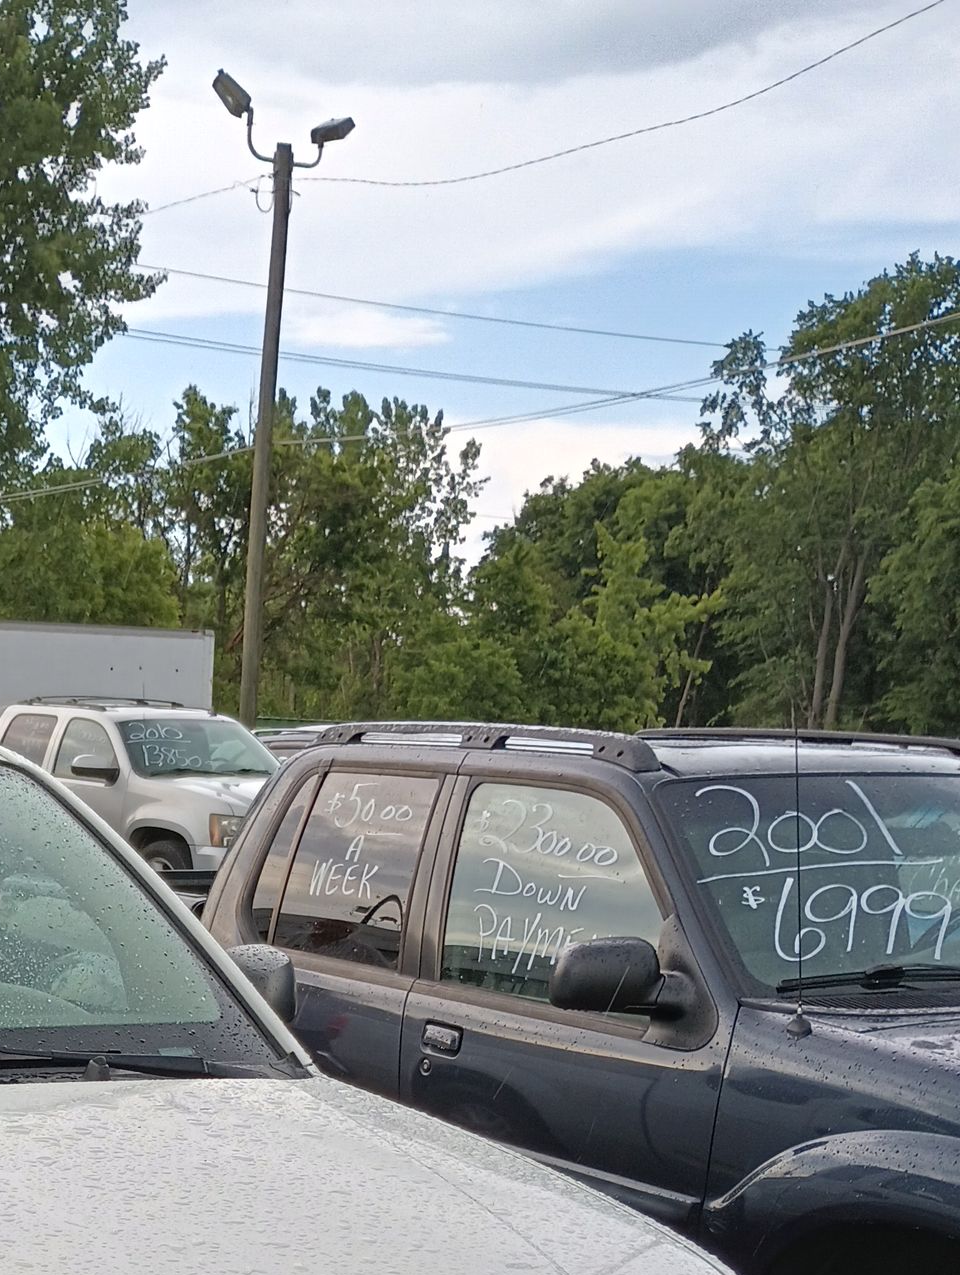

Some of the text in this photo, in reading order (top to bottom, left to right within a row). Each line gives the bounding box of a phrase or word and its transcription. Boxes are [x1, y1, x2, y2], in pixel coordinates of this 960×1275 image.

[128, 722, 183, 740] 2010
[345, 834, 365, 862] A
[694, 779, 903, 867] 2001
[309, 858, 379, 899] WEEK
[473, 903, 614, 974] PAYME
[741, 877, 952, 962] $6999
